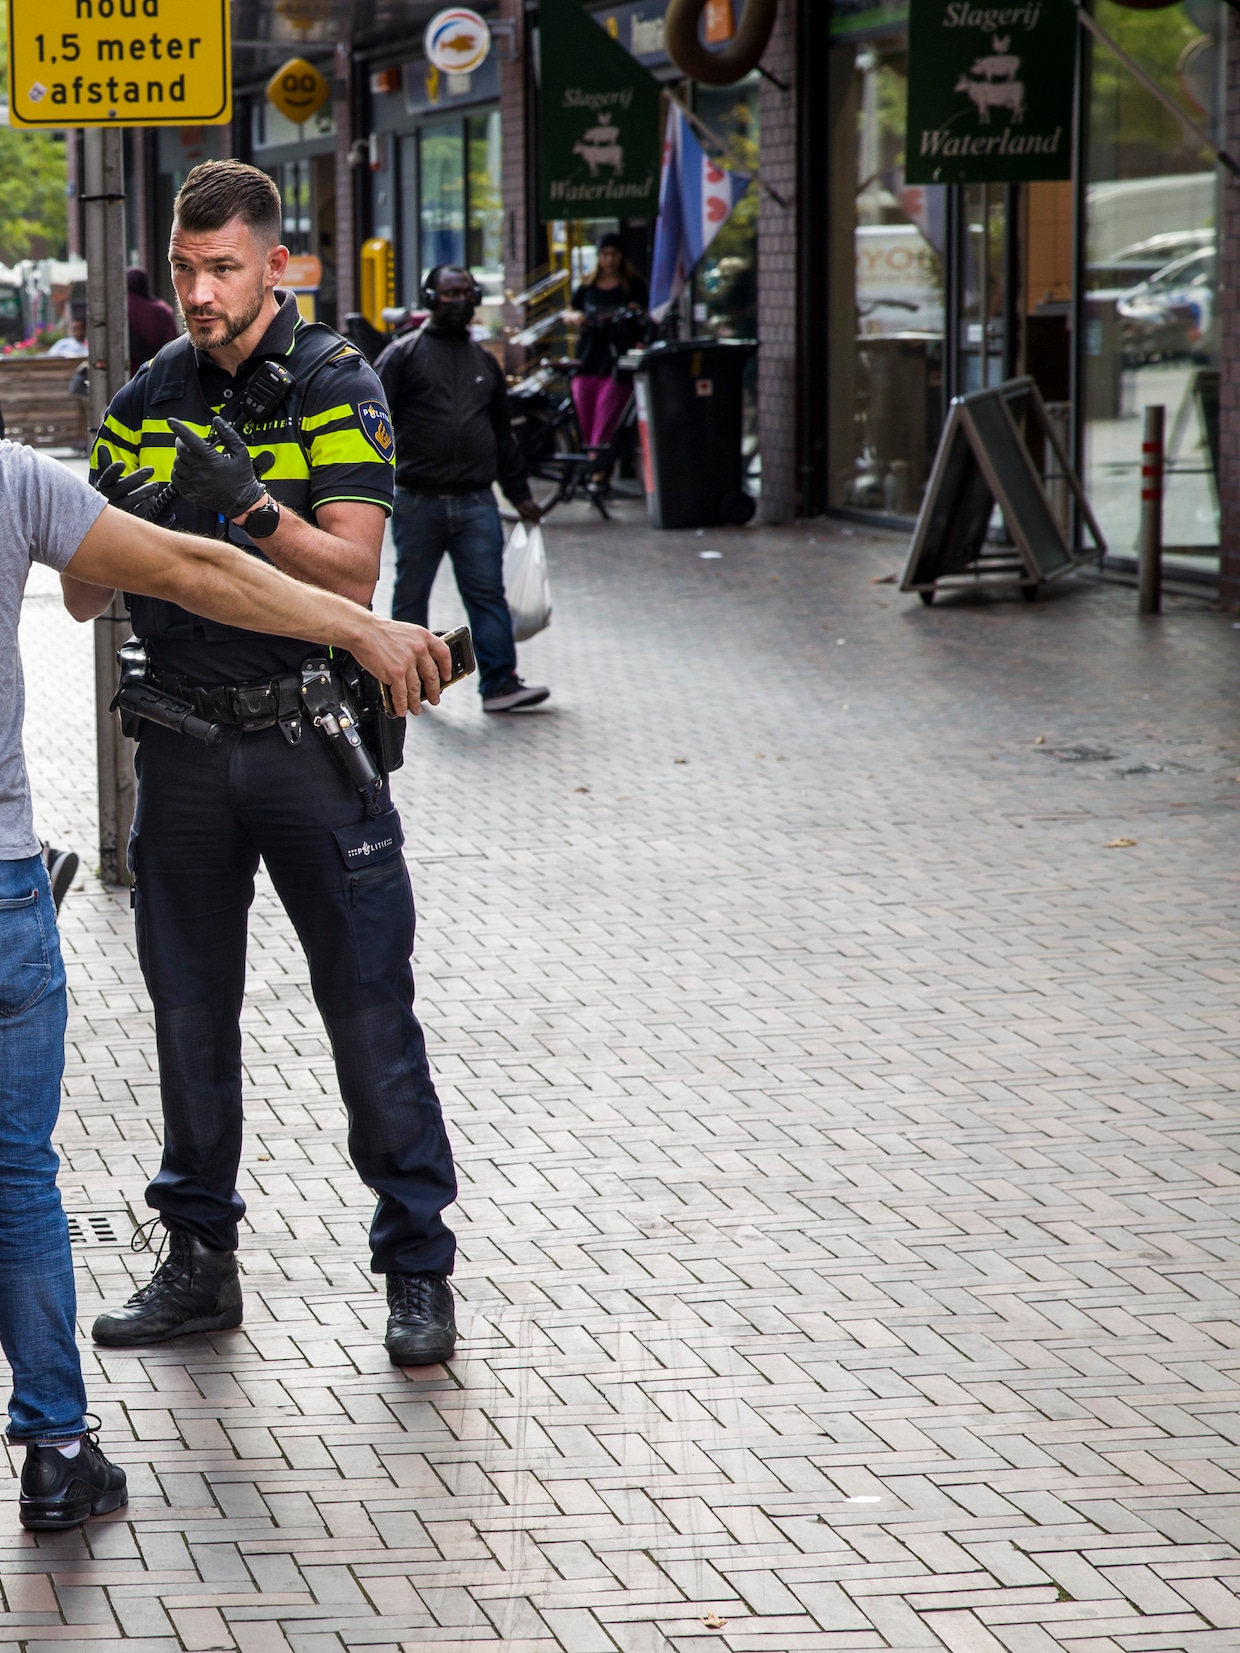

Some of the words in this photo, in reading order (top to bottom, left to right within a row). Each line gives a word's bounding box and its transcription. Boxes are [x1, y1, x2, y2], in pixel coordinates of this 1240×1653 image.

[76, 0, 159, 19] houd
[942, 1, 1043, 33] Slagerij
[35, 33, 81, 64] 1,5
[97, 32, 201, 62] meter
[50, 73, 185, 105] afstand
[562, 87, 634, 111] Slagerij
[919, 126, 1063, 158] Waterland
[549, 176, 653, 203] Waterland
[242, 419, 287, 435] OLITIE
